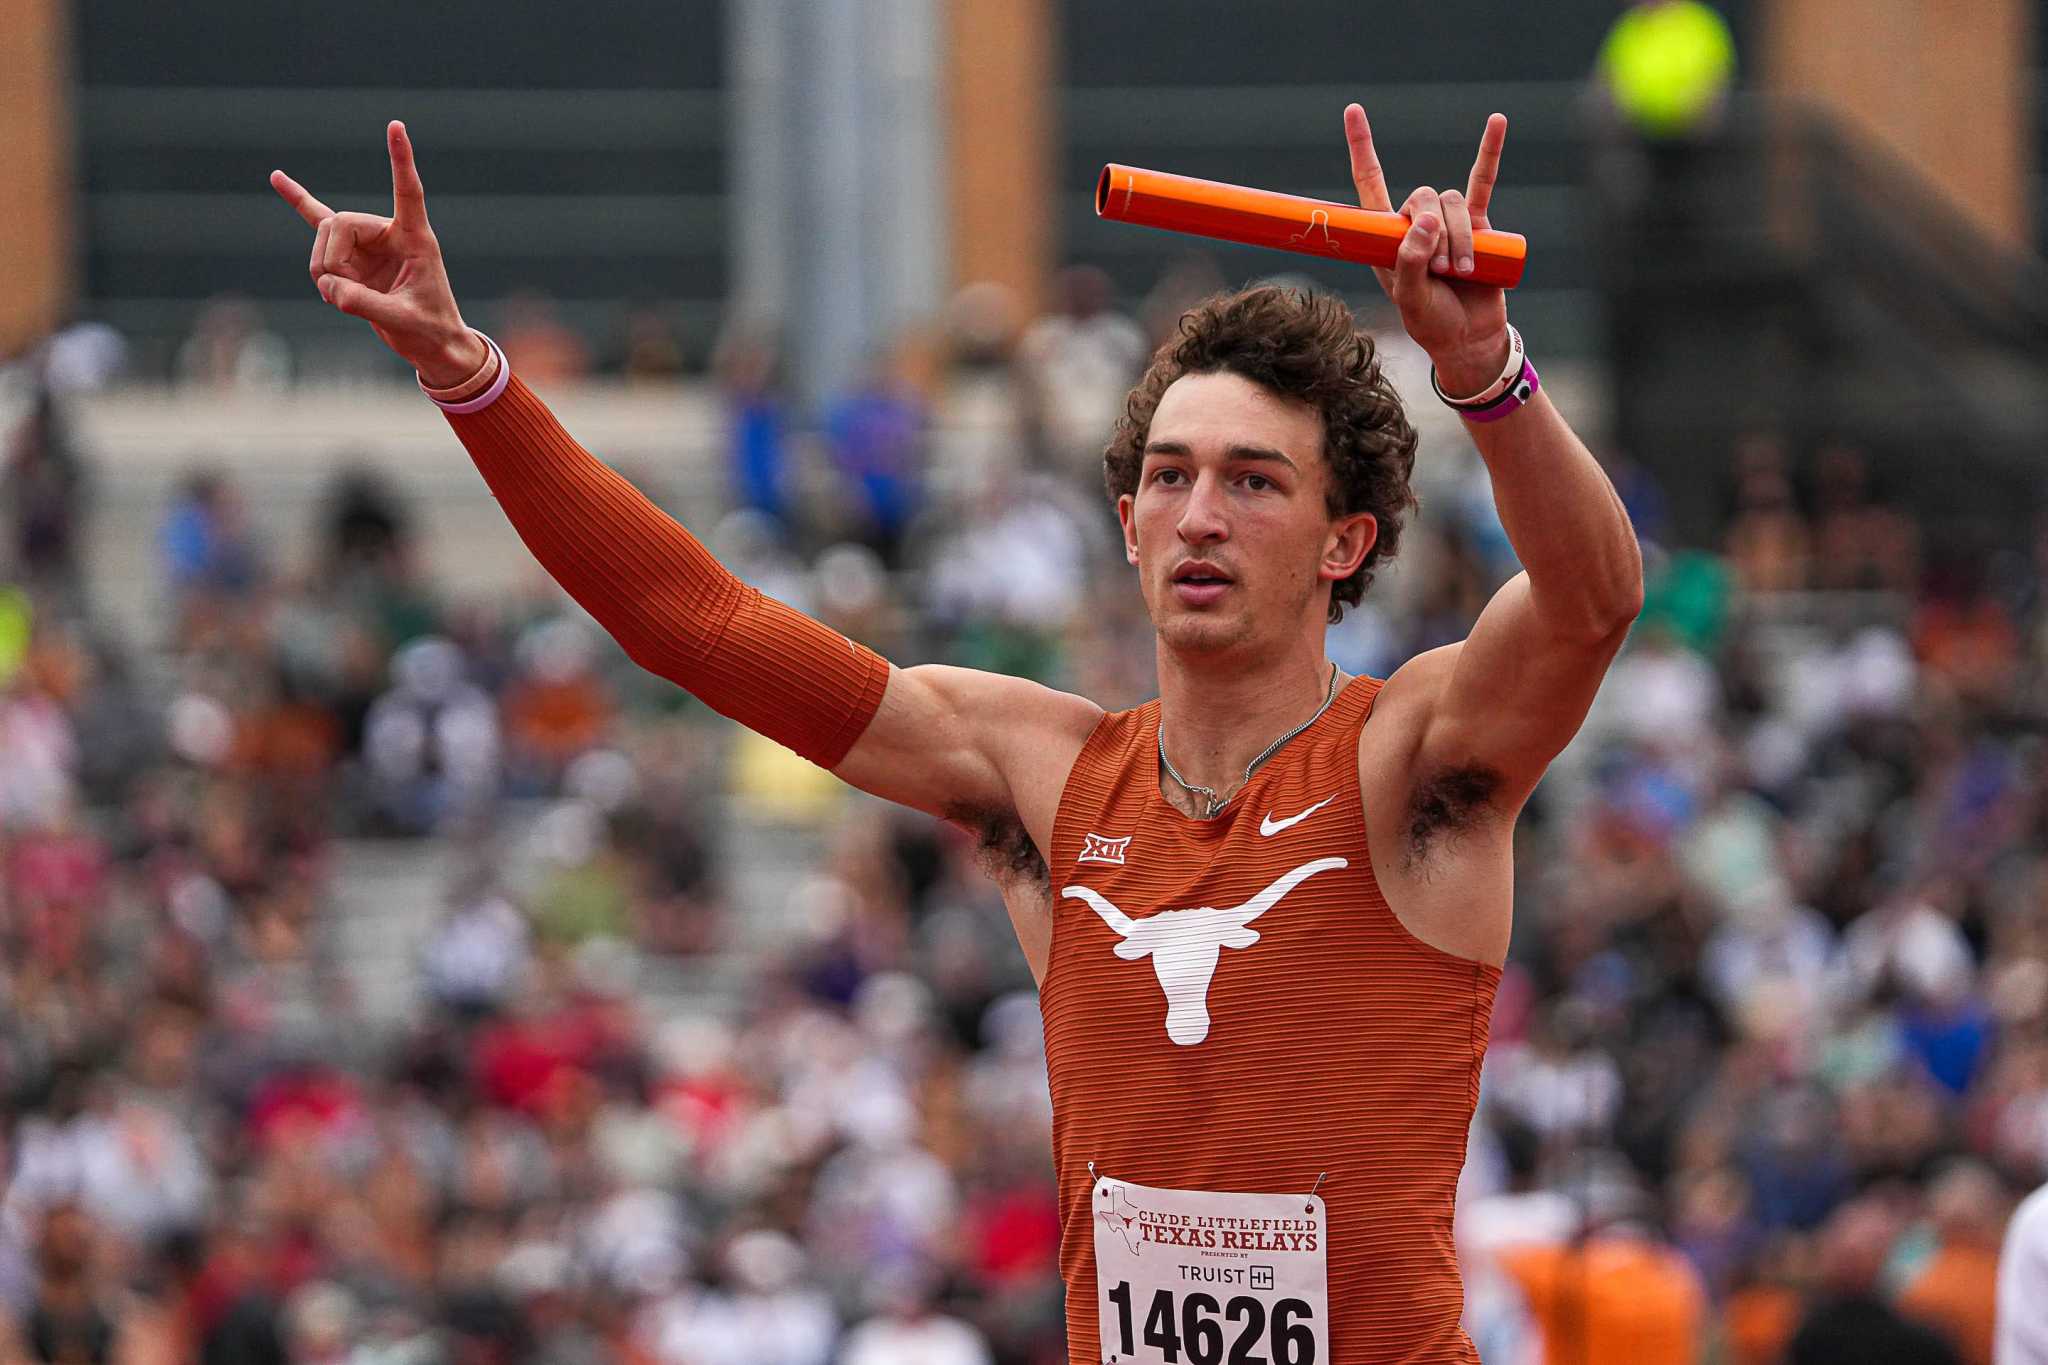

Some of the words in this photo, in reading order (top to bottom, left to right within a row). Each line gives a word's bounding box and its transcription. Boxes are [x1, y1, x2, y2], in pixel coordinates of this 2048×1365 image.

[1139, 1210, 1191, 1226] CLYDE
[1197, 1216, 1317, 1231] LITTLEFIELD
[1139, 1222, 1217, 1249] TEXAS
[1221, 1230, 1318, 1252] RELAYS
[1178, 1265, 1245, 1284] TRUIST
[1108, 1280, 1315, 1365] 14626
